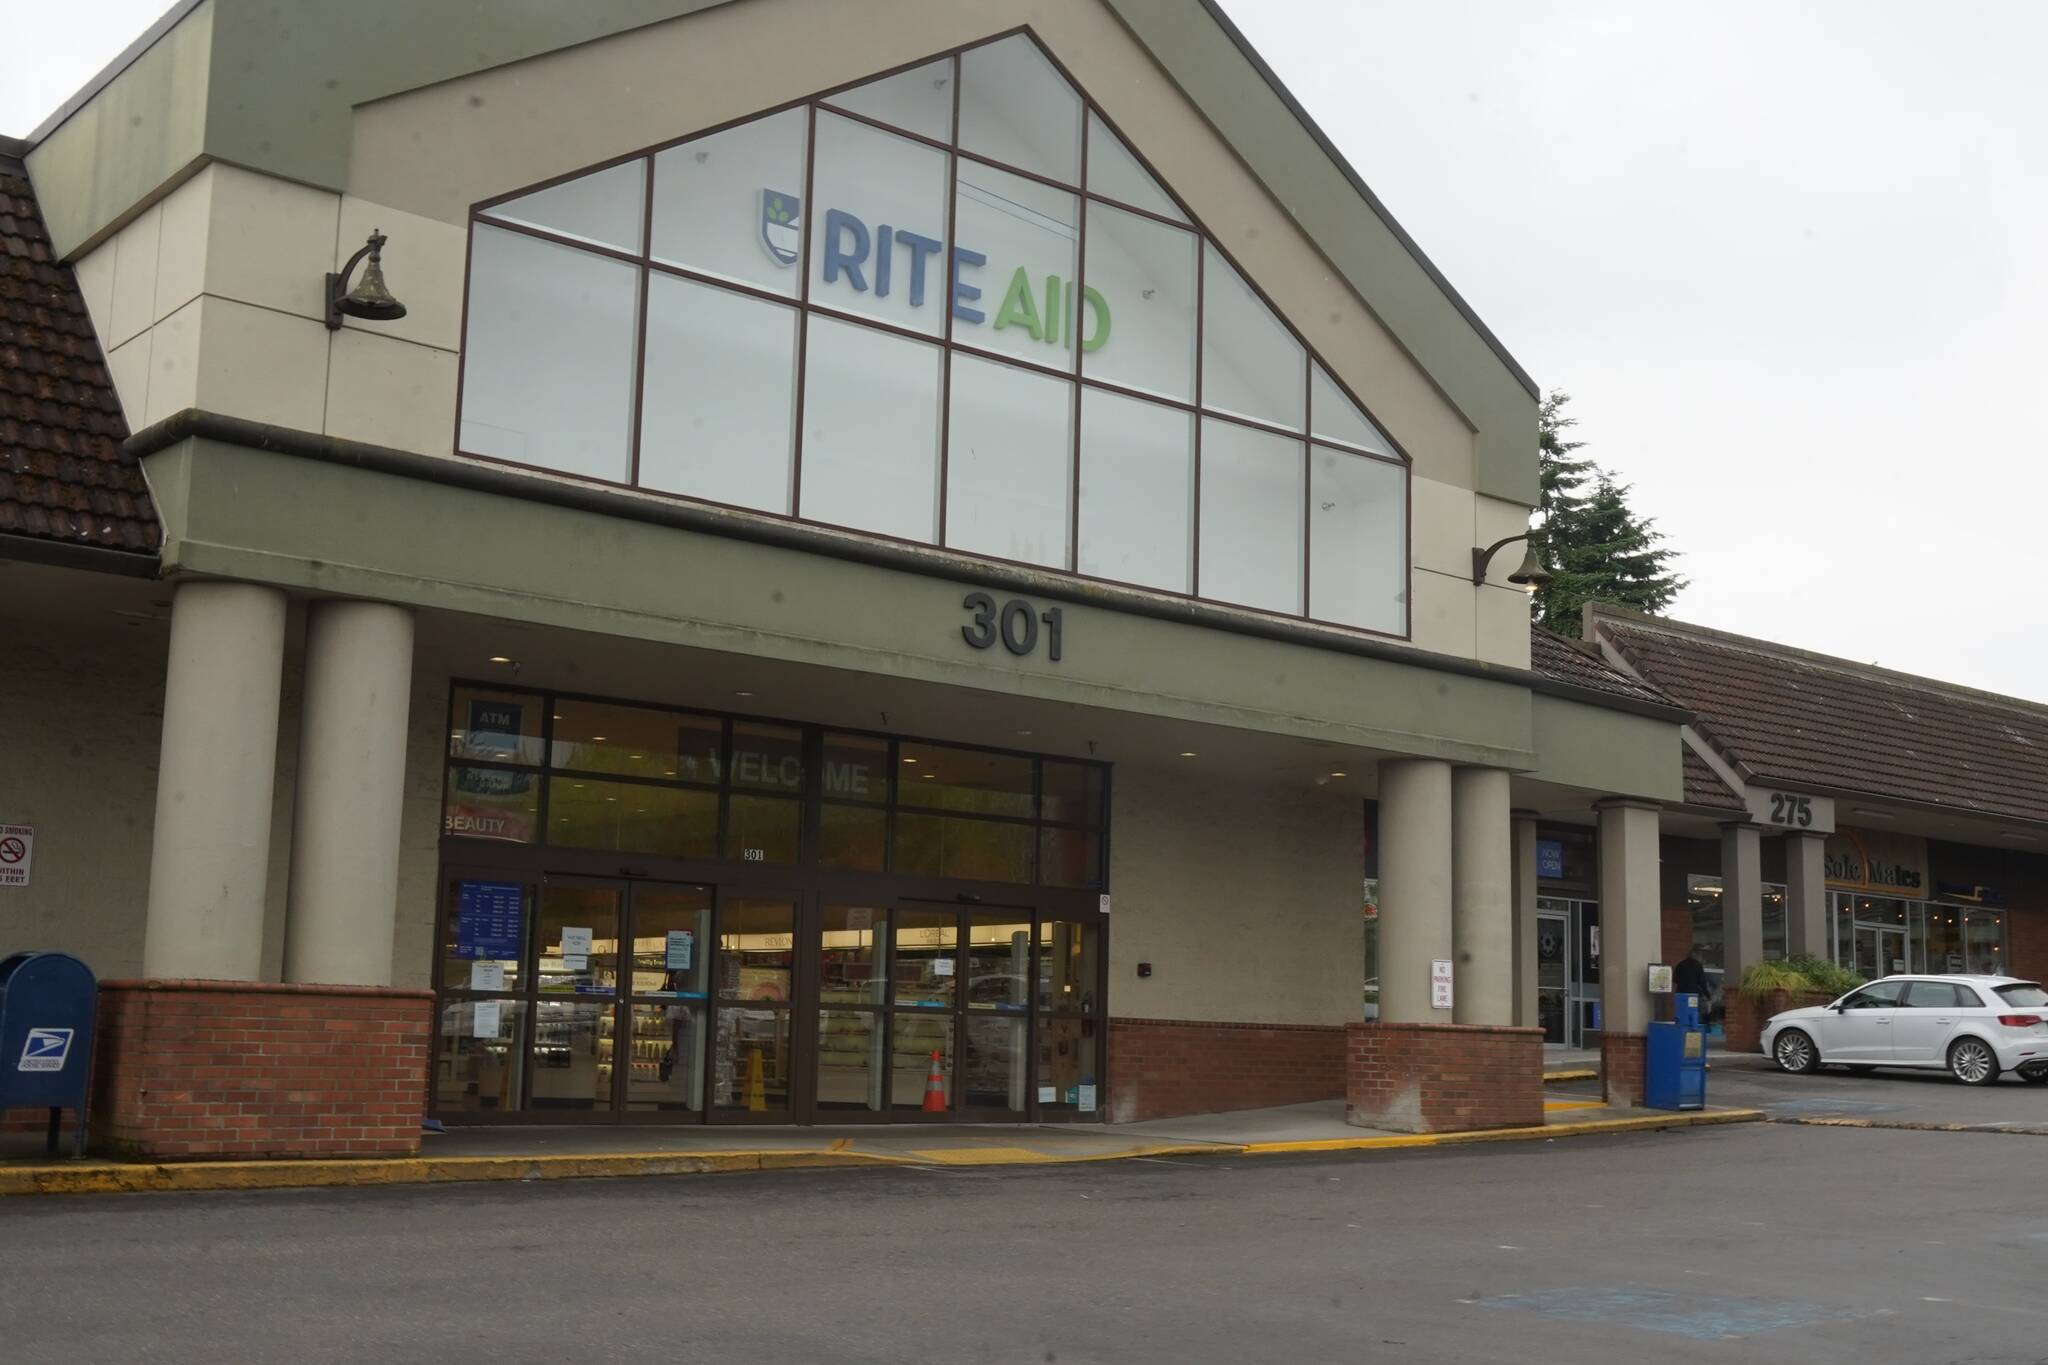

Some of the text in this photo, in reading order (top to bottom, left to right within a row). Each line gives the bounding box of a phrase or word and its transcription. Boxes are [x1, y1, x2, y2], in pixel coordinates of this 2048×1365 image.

[823, 208, 1111, 354] RITE AID
[961, 592, 1062, 661] 301
[480, 711, 510, 725] ATM
[1770, 793, 1812, 827] 275
[5, 827, 32, 835] SMOKING
[445, 815, 505, 833] BEAUTY
[744, 849, 763, 860] 301
[1542, 848, 1561, 858] NOW
[1542, 860, 1561, 870] OPEN
[1824, 854, 1921, 889] Sole Mates
